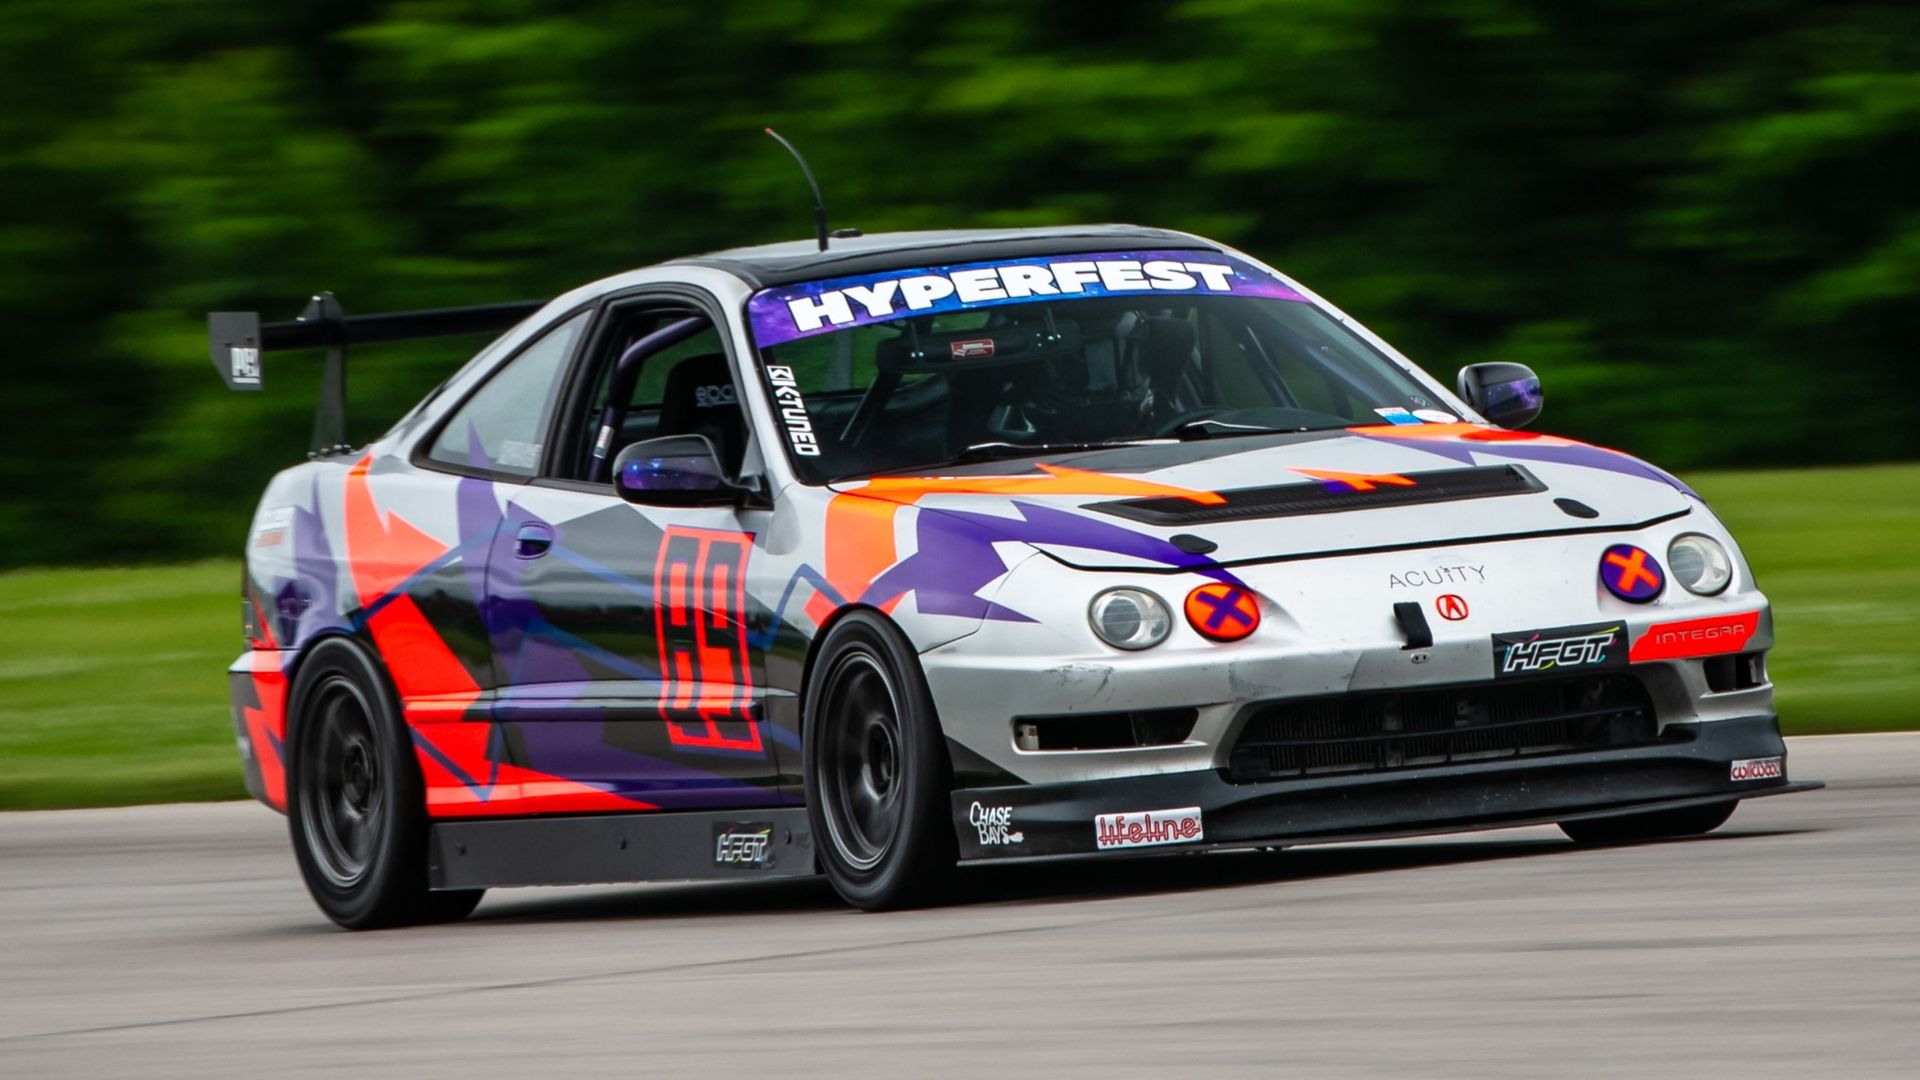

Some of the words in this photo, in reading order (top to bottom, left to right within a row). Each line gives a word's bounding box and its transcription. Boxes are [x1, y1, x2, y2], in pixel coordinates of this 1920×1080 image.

[787, 260, 1235, 332] HYPERFEST
[1389, 564, 1486, 589] ACUITY
[1655, 624, 1745, 645] INTEGRA
[1504, 634, 1614, 672] HFGT
[969, 801, 1013, 827] CHASE
[977, 821, 1010, 845] BAYS
[1098, 813, 1202, 846] lifeline
[716, 833, 768, 862] HFGT
